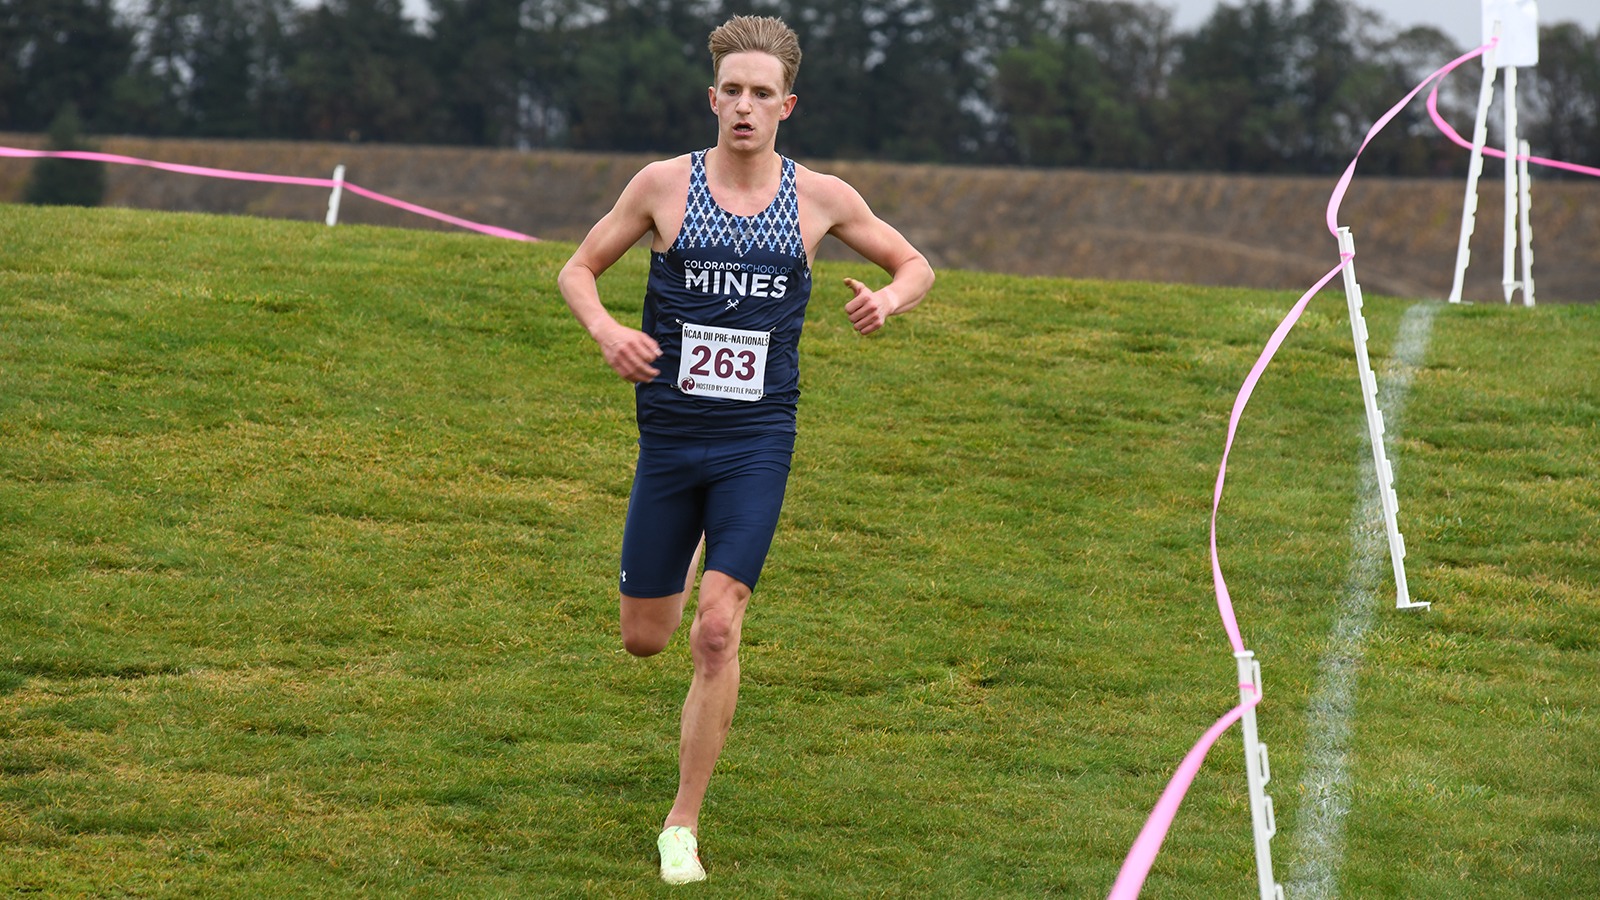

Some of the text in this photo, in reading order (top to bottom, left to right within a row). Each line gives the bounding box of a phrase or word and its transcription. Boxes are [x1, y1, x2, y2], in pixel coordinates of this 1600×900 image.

[684, 260, 741, 271] COLORADO
[685, 269, 788, 298] MINES
[684, 329, 702, 340] NCAA
[715, 333, 769, 346] PRE-NATIONALS
[690, 345, 756, 381] 263
[696, 383, 715, 391] HOSTED
[723, 386, 744, 394] SEATTLE
